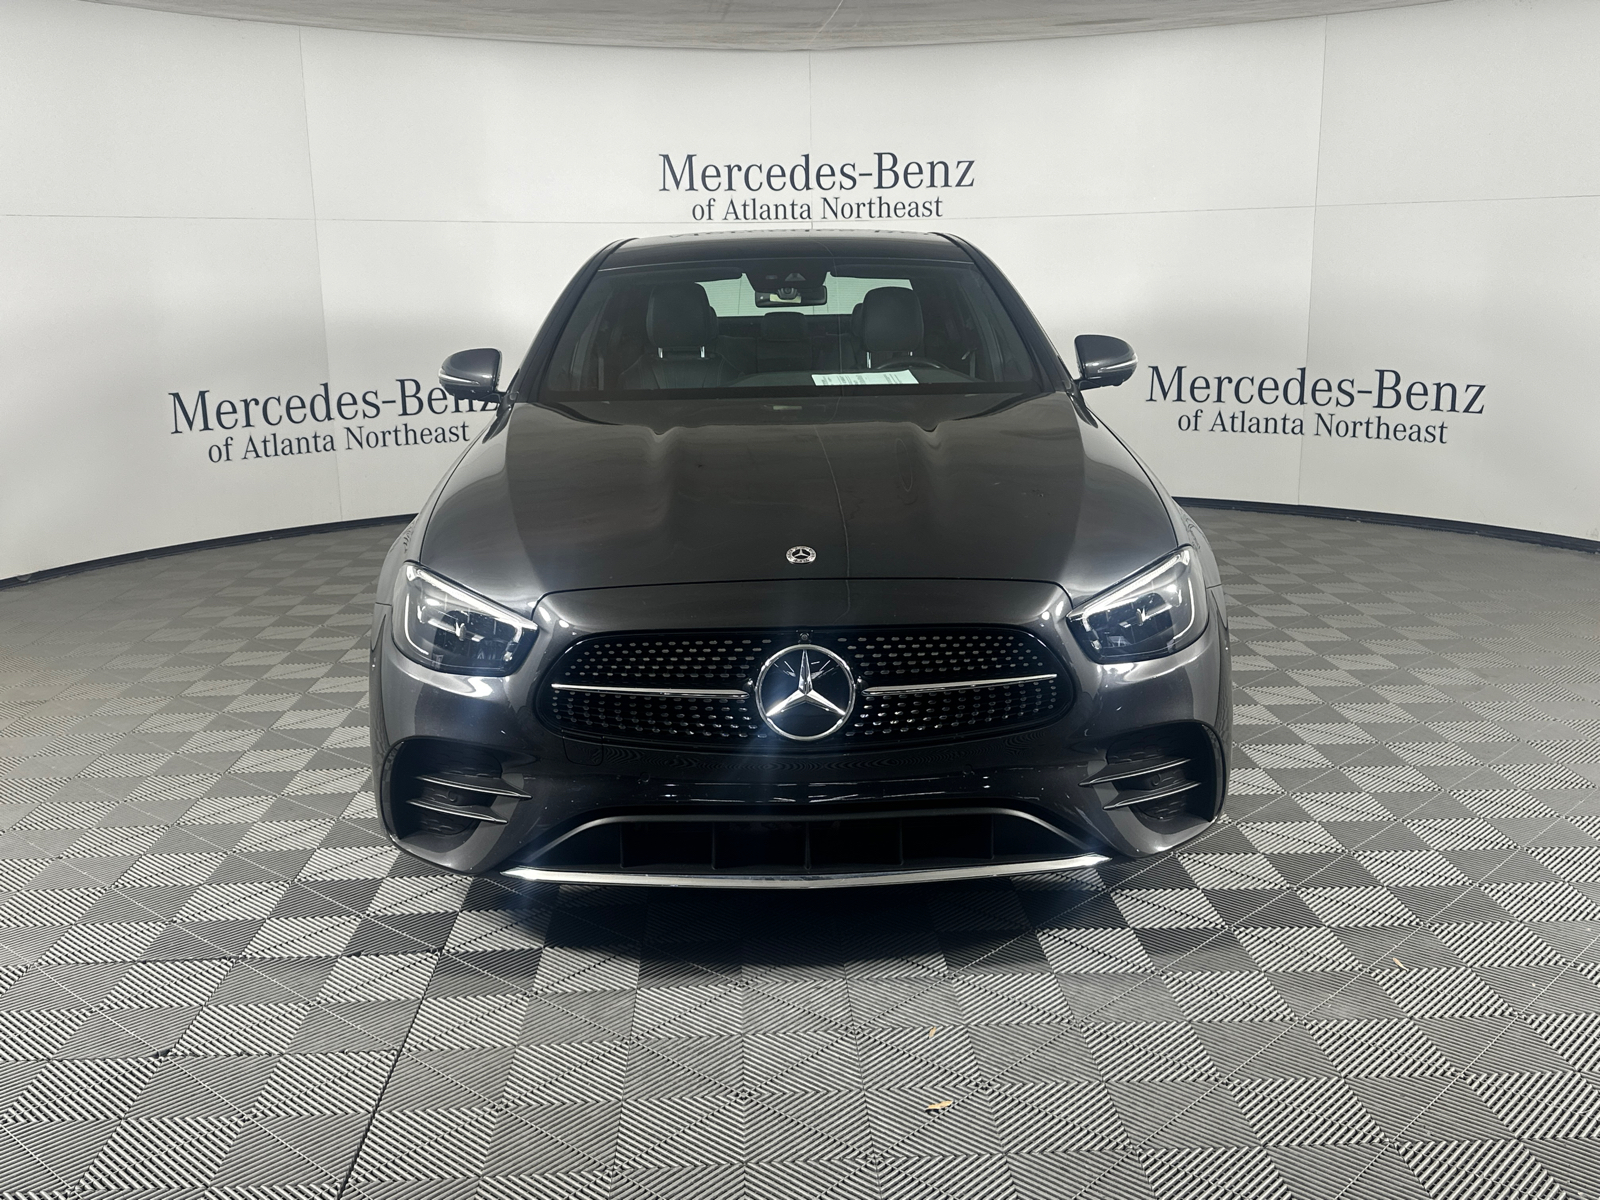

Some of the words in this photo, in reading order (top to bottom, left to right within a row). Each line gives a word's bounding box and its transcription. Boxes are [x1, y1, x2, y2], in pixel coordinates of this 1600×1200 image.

[658, 151, 976, 192] Mercedes-Benz
[691, 197, 717, 221] of
[722, 197, 812, 221] Atlanta
[820, 195, 943, 220] Northeast
[1145, 365, 1487, 415] Mercedes-Benz
[208, 436, 234, 464] of
[241, 431, 337, 461] Atlanta
[343, 421, 471, 451] Northeast
[1177, 408, 1204, 432] of
[1208, 409, 1305, 436] Atlanta
[1313, 412, 1449, 445] Northeast
